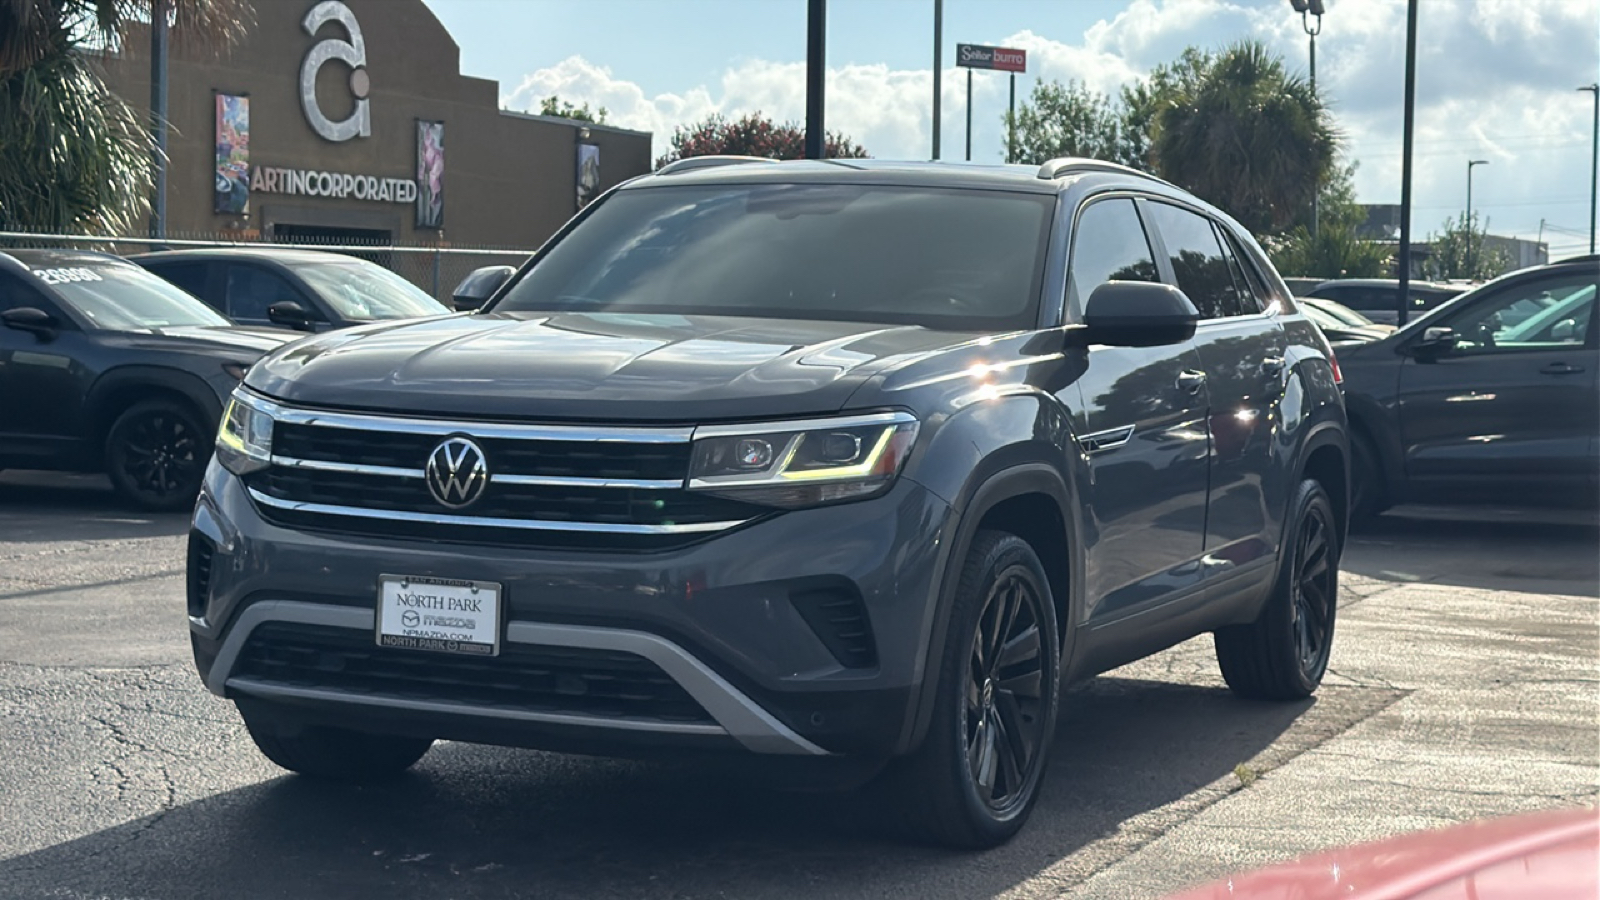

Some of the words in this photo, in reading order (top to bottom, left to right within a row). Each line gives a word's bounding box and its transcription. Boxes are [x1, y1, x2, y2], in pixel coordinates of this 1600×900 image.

[993, 49, 1024, 65] burro
[396, 592, 444, 610] NORTH
[448, 597, 482, 612] PARK
[423, 614, 476, 630] mazda
[383, 635, 417, 649] NORTH
[419, 639, 446, 651] PARK
